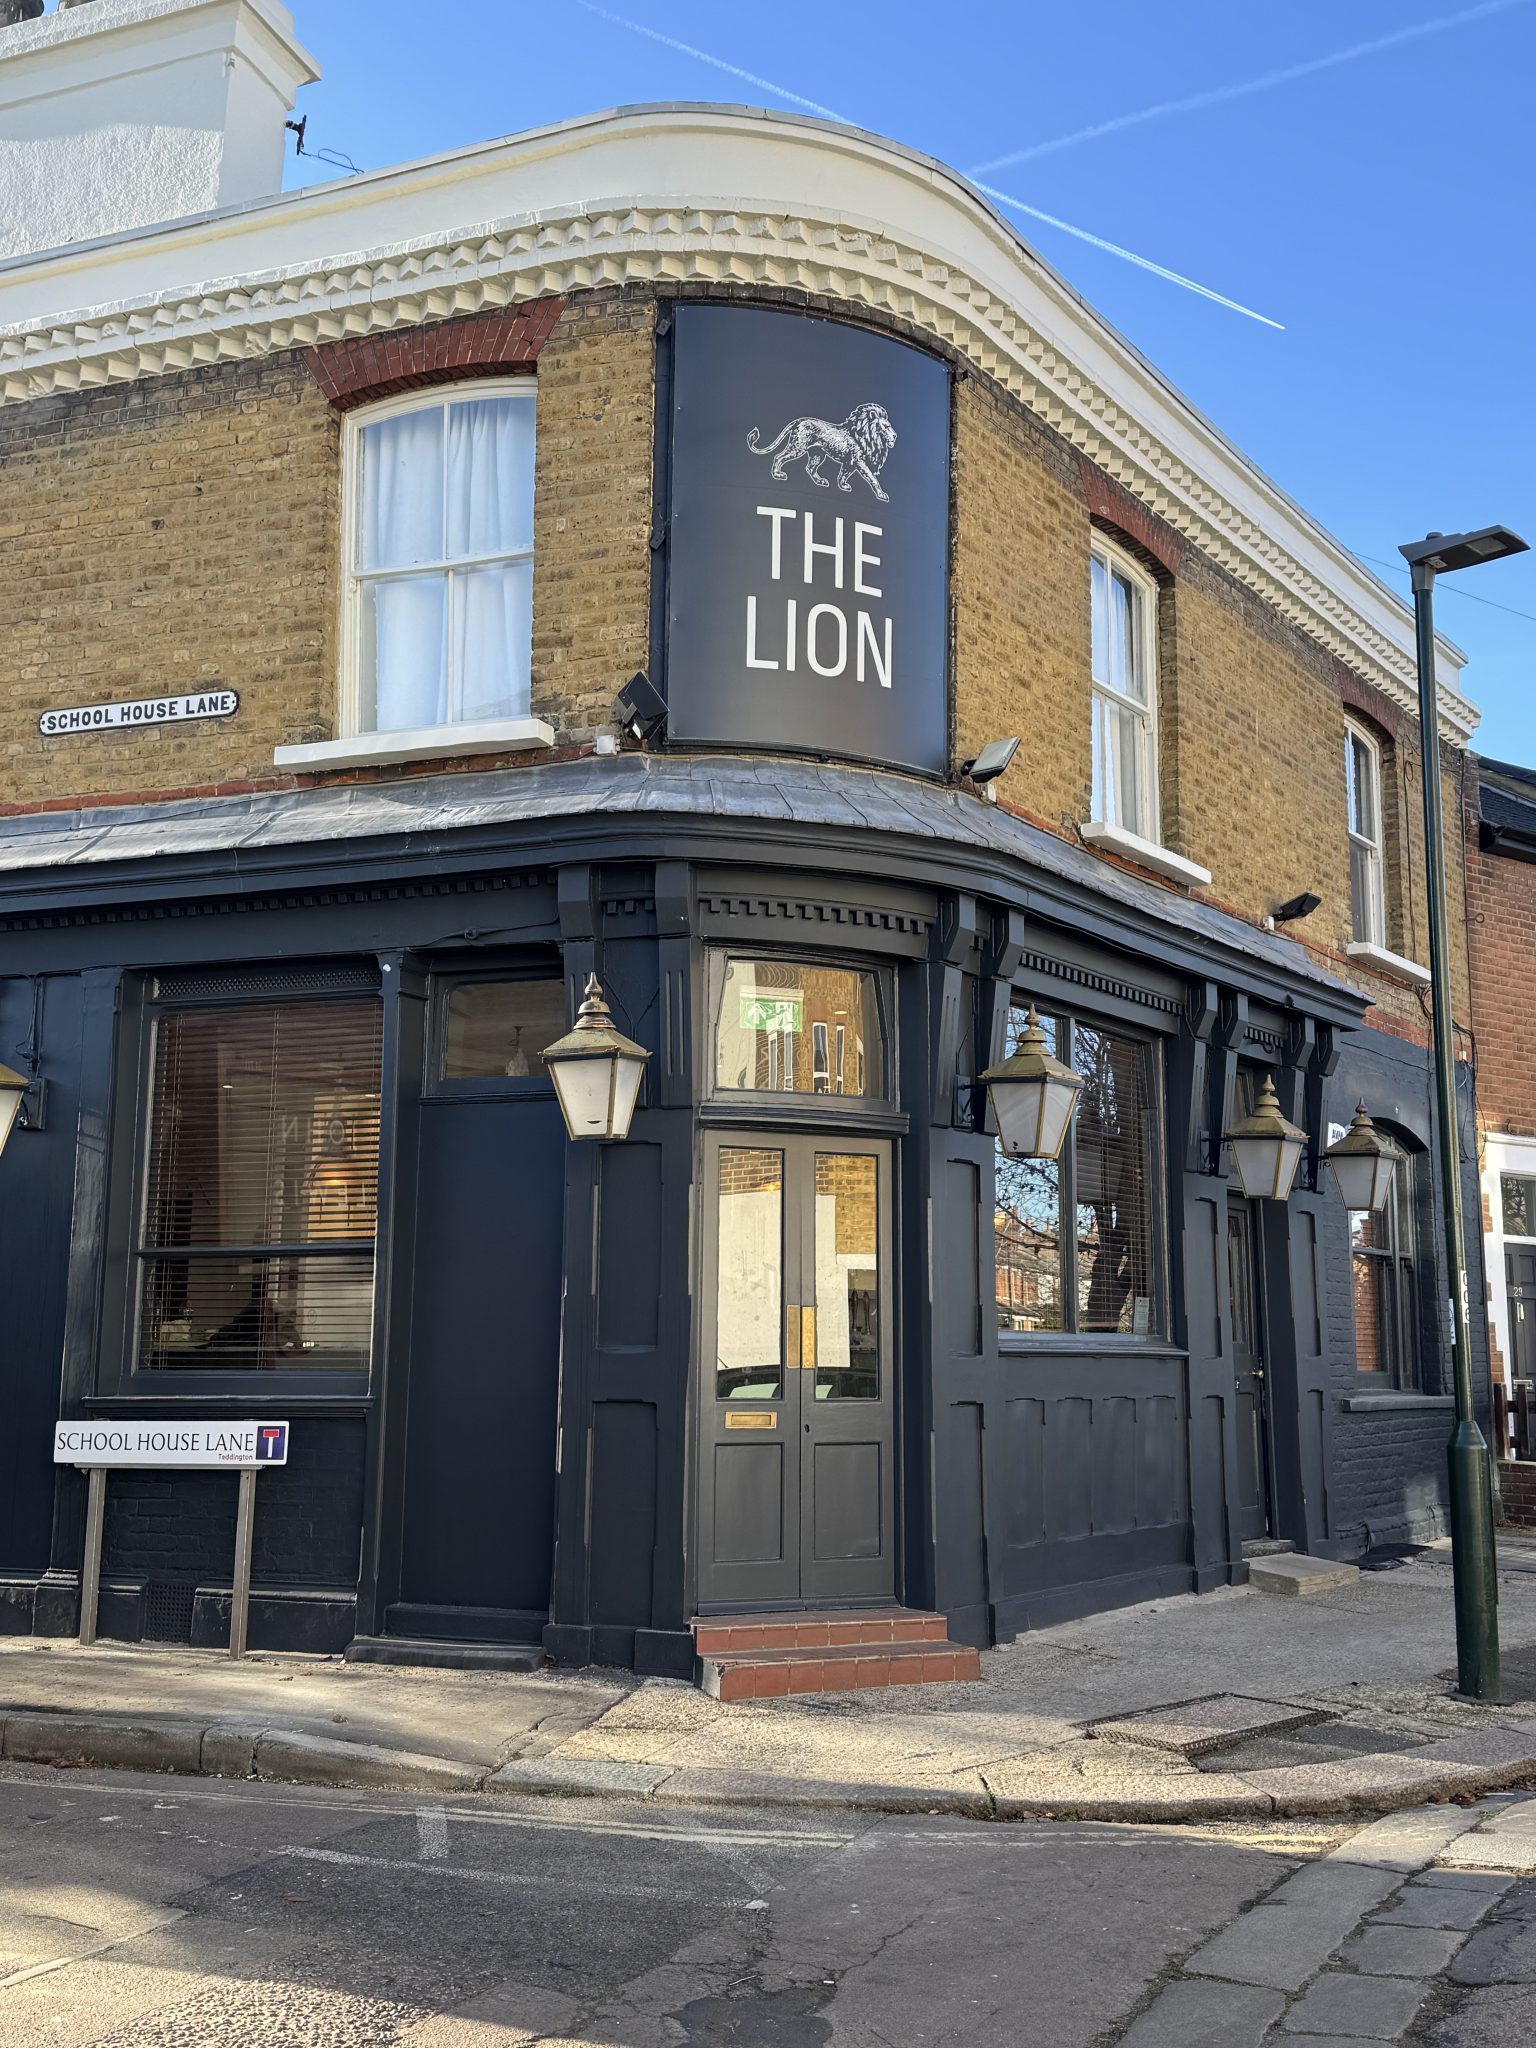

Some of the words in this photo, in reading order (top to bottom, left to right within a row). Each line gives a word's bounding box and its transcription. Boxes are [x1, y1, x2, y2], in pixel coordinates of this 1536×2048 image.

[757, 506, 882, 598] THE
[746, 595, 893, 689] LION
[47, 708, 113, 730] SCHOOL
[120, 701, 178, 722] HOUSE
[185, 695, 231, 715] LANE
[1513, 1286, 1523, 1297] 29
[57, 1432, 132, 1451] SCHOOL
[137, 1432, 200, 1451] HOUSE
[206, 1433, 254, 1452] LANE
[218, 1453, 253, 1462] Teddington
